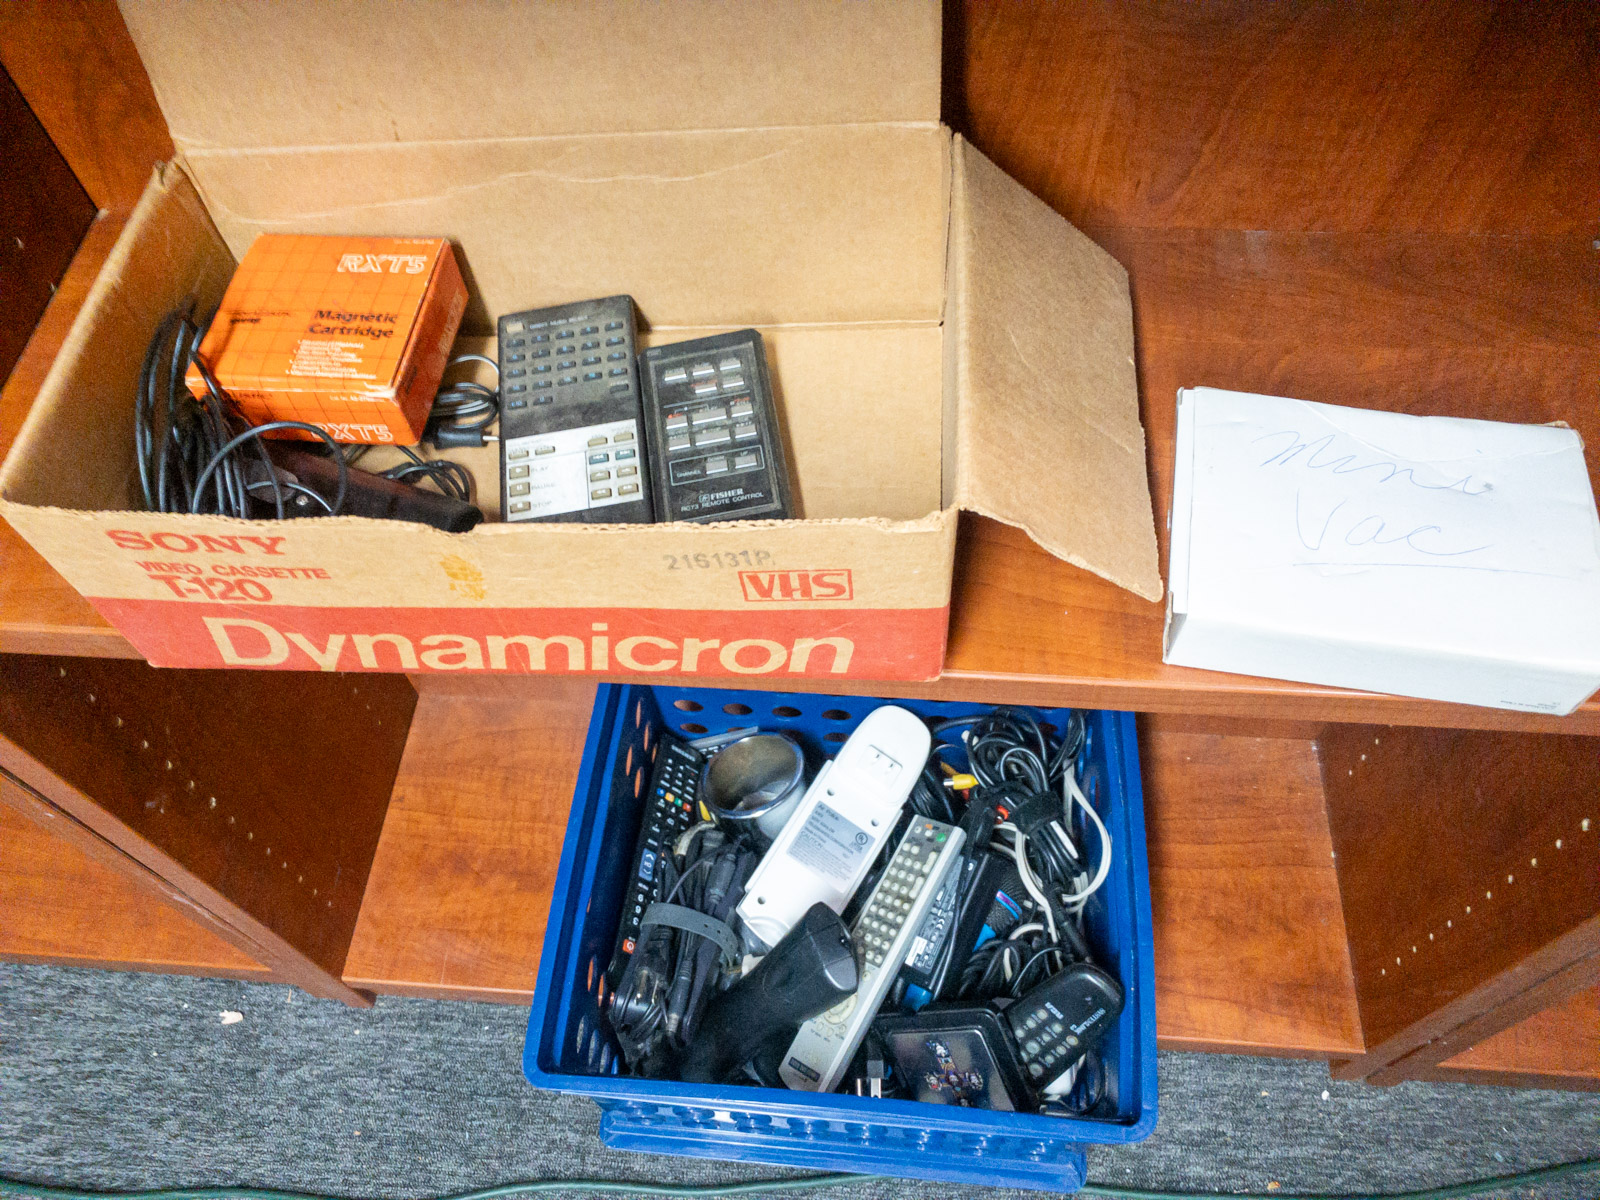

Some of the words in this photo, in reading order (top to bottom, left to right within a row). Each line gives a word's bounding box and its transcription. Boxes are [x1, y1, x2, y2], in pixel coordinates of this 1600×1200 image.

[337, 254, 428, 274] RXT5
[314, 310, 398, 324] Magnetic
[308, 323, 394, 338] Cartridge
[702, 498, 730, 508] REMOTE
[733, 492, 764, 502] CONTROL
[711, 488, 744, 501] FISHER
[1296, 487, 1497, 556] Vac
[105, 529, 286, 556] SONY
[135, 561, 203, 576] VIDEO
[212, 564, 333, 580] CASSETTE
[147, 573, 273, 602] T-120
[744, 571, 847, 600] VHS
[201, 616, 856, 673] Dynamicron
